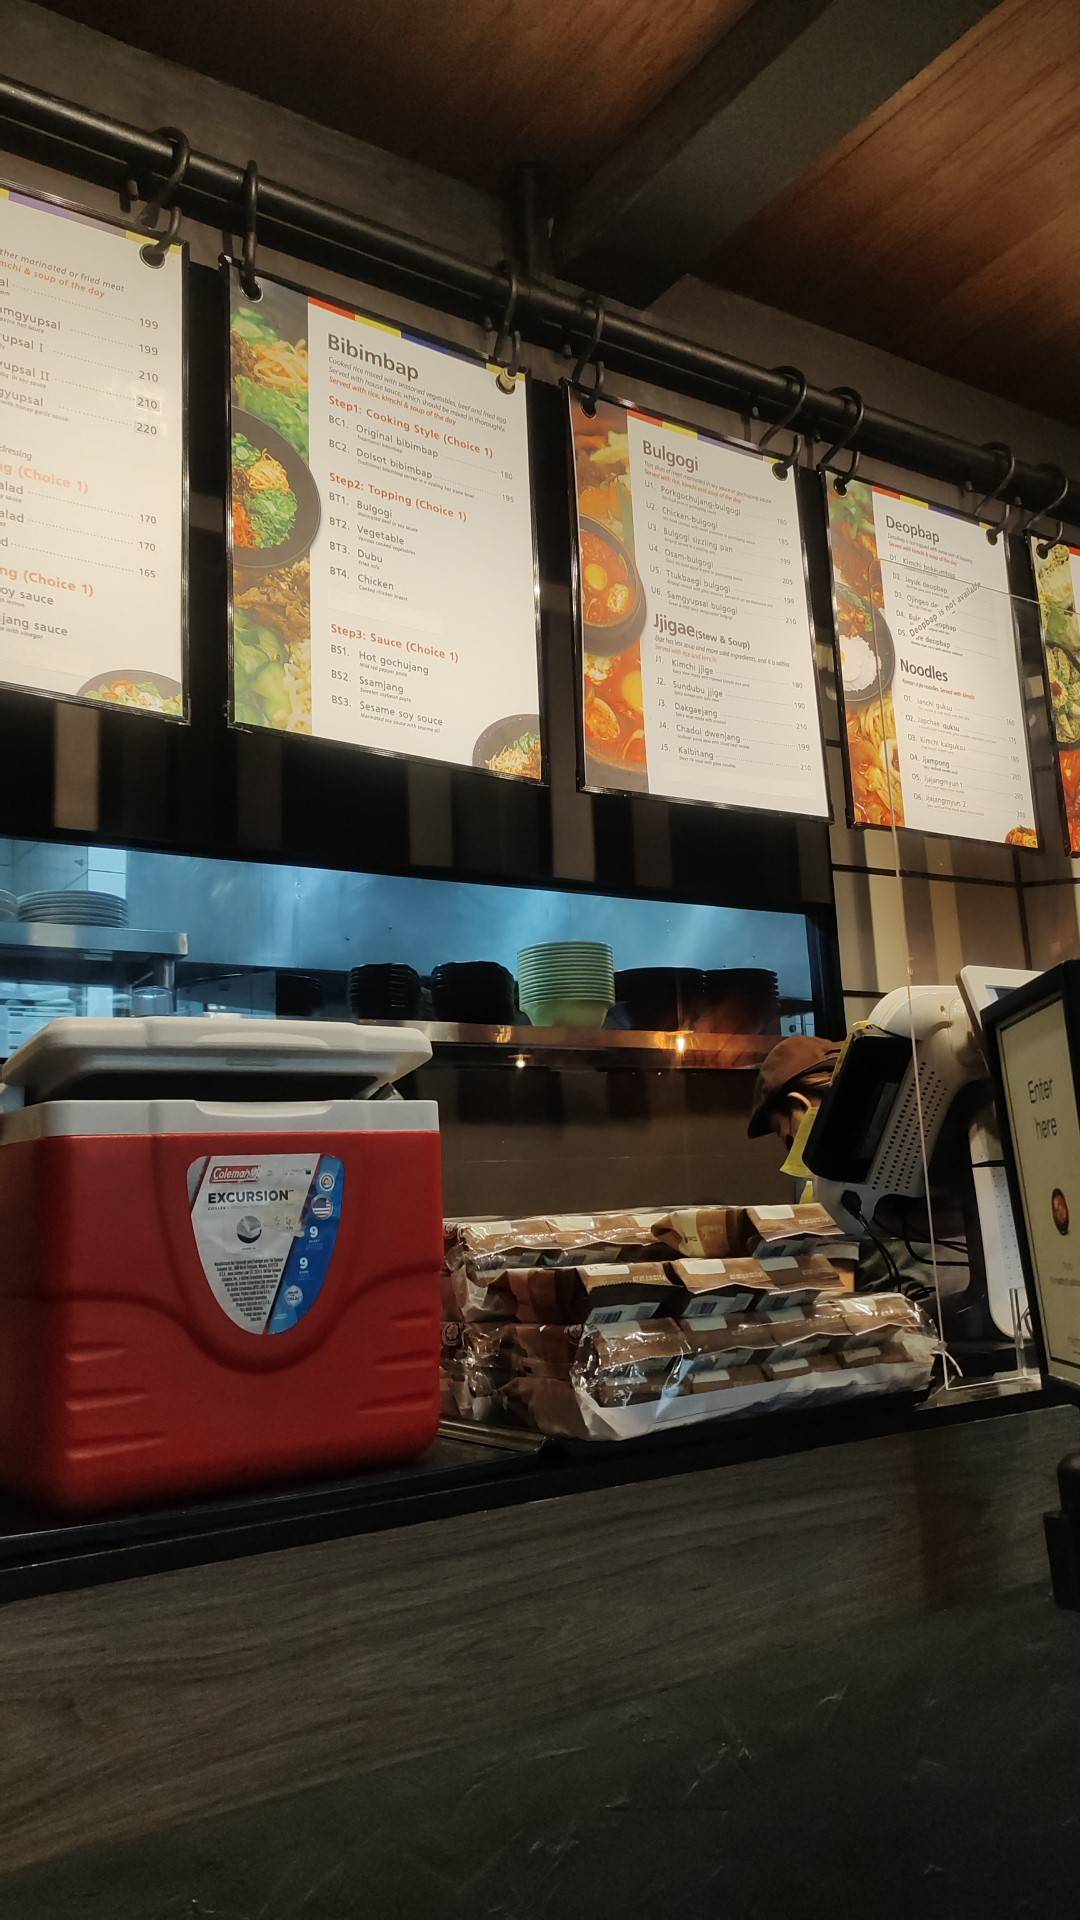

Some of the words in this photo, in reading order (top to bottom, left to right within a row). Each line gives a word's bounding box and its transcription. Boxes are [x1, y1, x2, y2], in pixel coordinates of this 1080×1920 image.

[34, 271, 56, 283] soup
[59, 278, 68, 286] of
[71, 281, 86, 291] the
[88, 286, 105, 298] day
[69, 270, 79, 279] or
[81, 273, 100, 285] fried
[102, 281, 124, 292] meat
[139, 318, 159, 330] 199
[139, 344, 159, 356] 199
[328, 333, 419, 382] Bibimbap
[138, 371, 159, 383] 210
[329, 376, 351, 389] Served
[352, 385, 366, 394] with
[382, 394, 402, 406] kimchi
[410, 405, 424, 415] soup
[433, 411, 443, 421] the
[444, 416, 456, 426] day
[351, 375, 364, 384] with
[403, 393, 420, 404] which
[442, 405, 449, 414] be
[353, 366, 363, 375] rice
[384, 376, 397, 386] with
[471, 407, 482, 416] and
[137, 397, 158, 410] 210
[136, 423, 157, 435] 220
[329, 395, 362, 414] Step1:
[366, 408, 410, 432] Cooking
[414, 424, 440, 440] Style
[443, 434, 481, 453] (Choice
[484, 447, 493, 459] 1)
[329, 415, 349, 429] BC1.
[356, 424, 393, 443] Original
[396, 435, 439, 458] bibimbap
[329, 439, 350, 453] BC2.
[356, 447, 387, 465] Dolsot
[390, 458, 433, 479] bibimbap
[643, 440, 699, 473] Bulgogi
[329, 472, 364, 490] Step2:
[368, 484, 411, 506] Topping
[415, 498, 454, 518] (Choice
[458, 510, 467, 523] 1)
[329, 492, 349, 505] BT1.
[357, 500, 393, 518] Bulgogi
[140, 514, 157, 525] 170
[662, 506, 718, 530] Chicken-bulgogi
[329, 516, 350, 530] BT2.
[357, 523, 405, 545] Vegetable
[663, 527, 690, 543] Bulgogi
[692, 536, 718, 551] sizzling
[720, 544, 733, 555] pan
[886, 515, 940, 545] Deopbap
[139, 541, 156, 551] 170
[329, 541, 350, 555] BT3.
[357, 548, 383, 563] Dubu
[664, 548, 714, 569] Osam-bulgogi
[23, 570, 77, 591] (Choice
[82, 584, 94, 597] 1)
[139, 568, 156, 578] 165
[329, 566, 350, 580] BT4.
[357, 574, 394, 590] Chicken
[666, 569, 702, 587] Ttukbaegi
[703, 579, 731, 593] bulgogi
[20, 591, 54, 606] sauce
[711, 601, 738, 616] bulgogi
[34, 622, 69, 636] sauce
[909, 614, 938, 637] Deopbap
[945, 600, 957, 612] not
[331, 623, 366, 640] Step3:
[370, 633, 402, 648] Sauce
[406, 641, 445, 658] (Choice
[449, 652, 459, 664] 1)
[719, 635, 726, 644] &
[728, 637, 751, 651] Soup)
[331, 644, 350, 657] BS1.
[359, 650, 377, 662] Hot
[380, 657, 429, 676] gochujang
[671, 658, 696, 671] Kimchi
[900, 658, 949, 682] Noodles
[331, 669, 351, 682] BS2.
[359, 675, 404, 695] Ssamjang
[672, 680, 705, 694] Sundubu
[331, 695, 351, 707] BS3.
[359, 700, 395, 716] Sesame
[399, 710, 414, 722] soy
[674, 702, 718, 719] Dakgaejang
[676, 724, 702, 736] Chadol
[704, 728, 741, 743] dwenjang
[678, 746, 714, 760] Kalbitang
[1027, 1079, 1053, 1104] Enter
[1034, 1117, 1058, 1139] here
[213, 1167, 250, 1180] Coleman
[208, 1189, 289, 1204] EXCURSION
[309, 1226, 318, 1238] 9
[300, 1257, 308, 1269] 9
